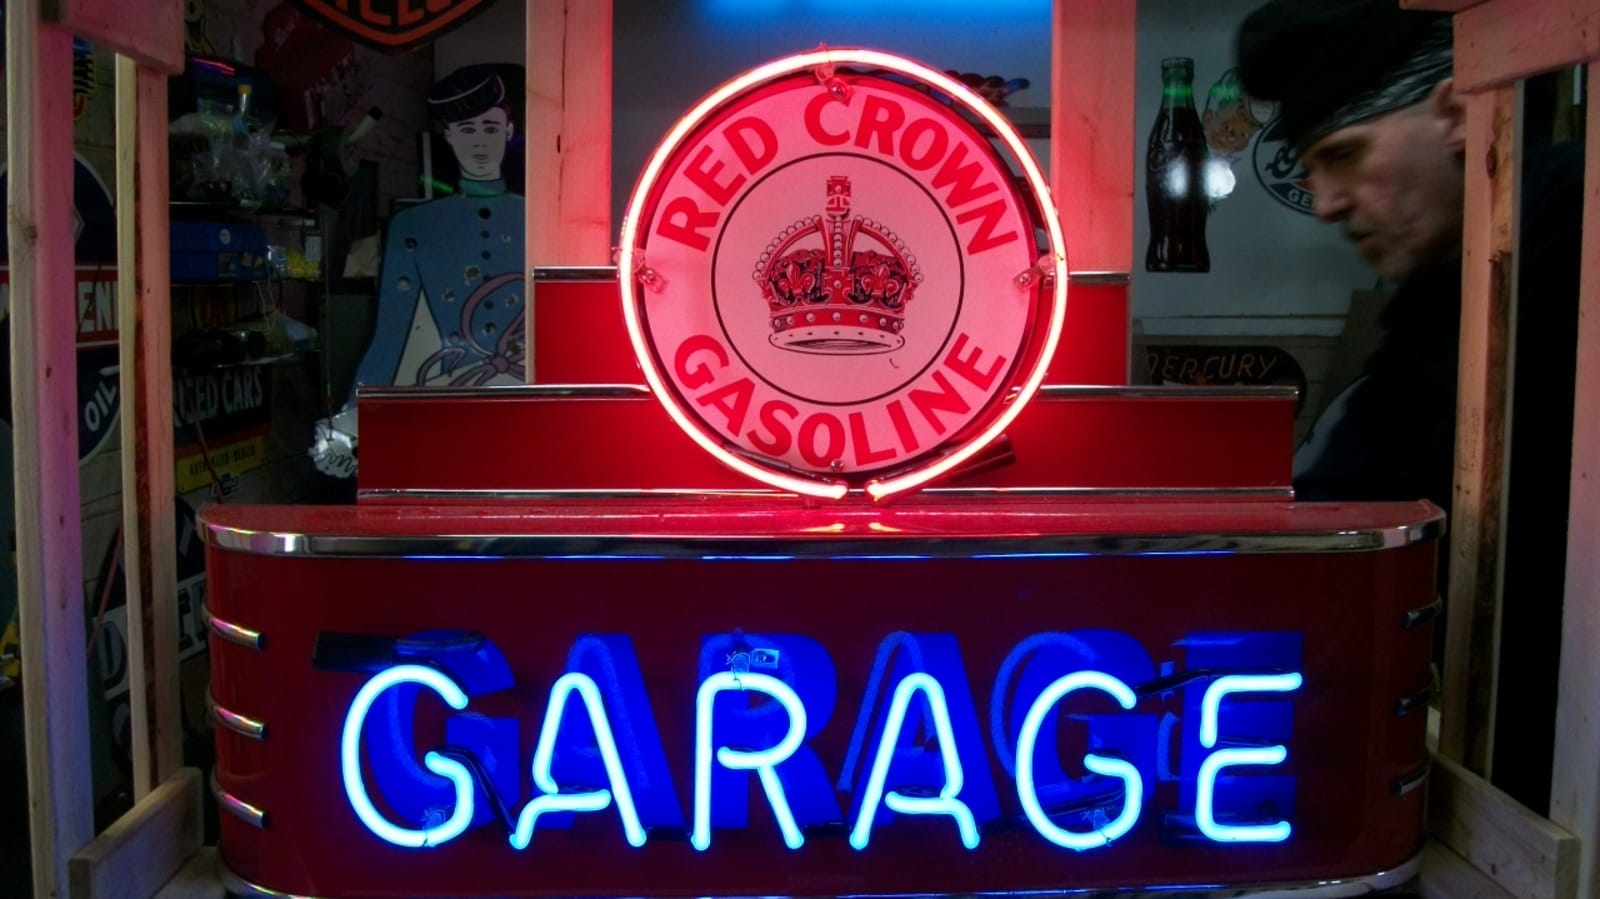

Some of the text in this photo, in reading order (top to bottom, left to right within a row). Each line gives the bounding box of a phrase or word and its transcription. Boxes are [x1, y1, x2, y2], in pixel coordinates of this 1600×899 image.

[656, 116, 779, 254] RED
[803, 93, 1019, 257] CROWN
[221, 365, 265, 416] CARS
[673, 332, 1007, 468] GASOLINE
[340, 666, 1304, 851] GARAGE
